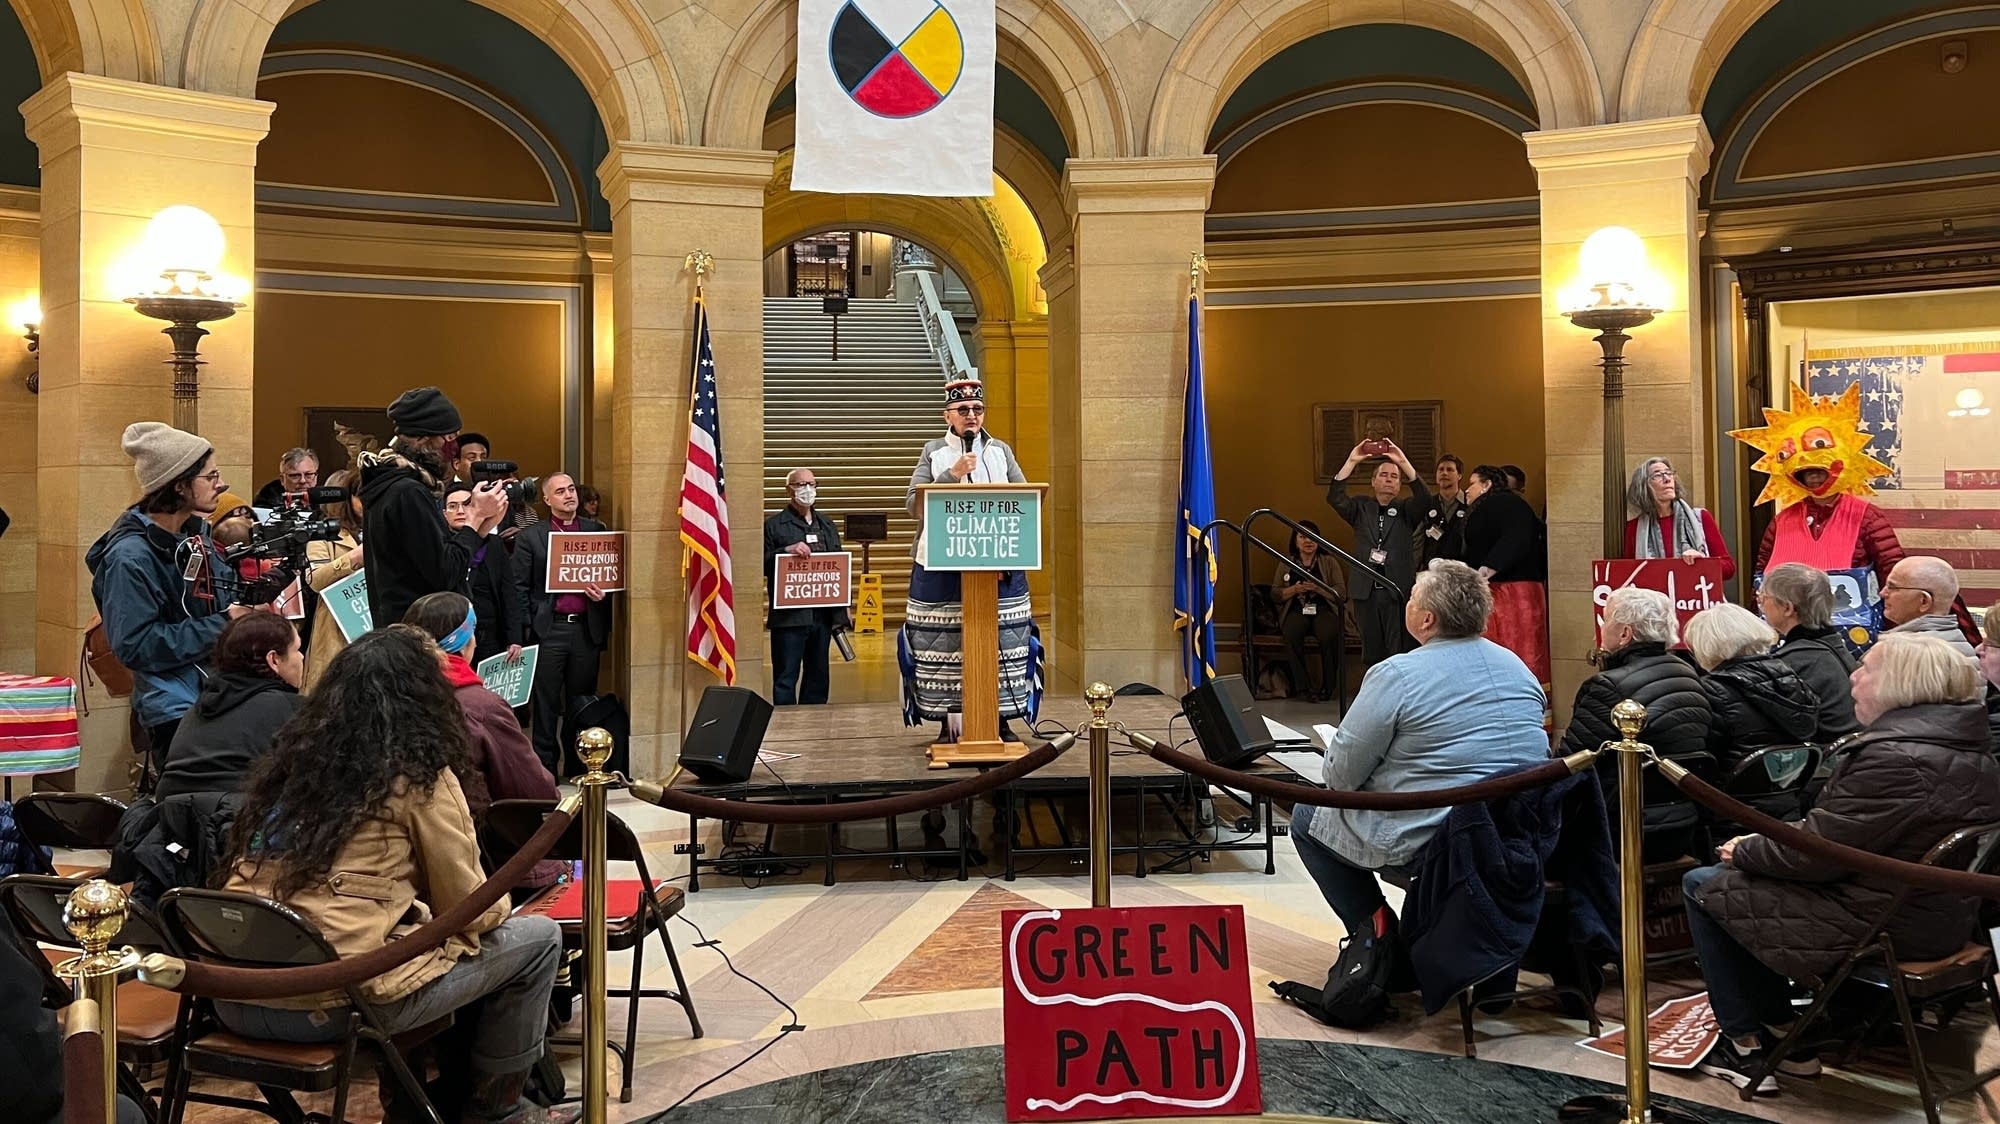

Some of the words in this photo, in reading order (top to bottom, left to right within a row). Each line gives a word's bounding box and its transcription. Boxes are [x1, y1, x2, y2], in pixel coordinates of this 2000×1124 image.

[945, 501, 976, 514] RISE
[980, 501, 994, 514] UP
[997, 501, 1027, 514] FOR
[946, 515, 1020, 535] CLIMATE
[563, 541, 588, 552] RISE
[591, 541, 602, 552] UP
[946, 535, 1019, 559] JUSTICE
[558, 566, 619, 582] RIGHTS
[787, 561, 808, 571] RISE
[811, 561, 821, 570] UP
[822, 560, 840, 571] FOR
[784, 583, 841, 599] RIGHTS
[491, 682, 521, 700] TICE
[1028, 917, 1231, 984] GREEN
[1056, 1027, 1225, 1089] PATH
